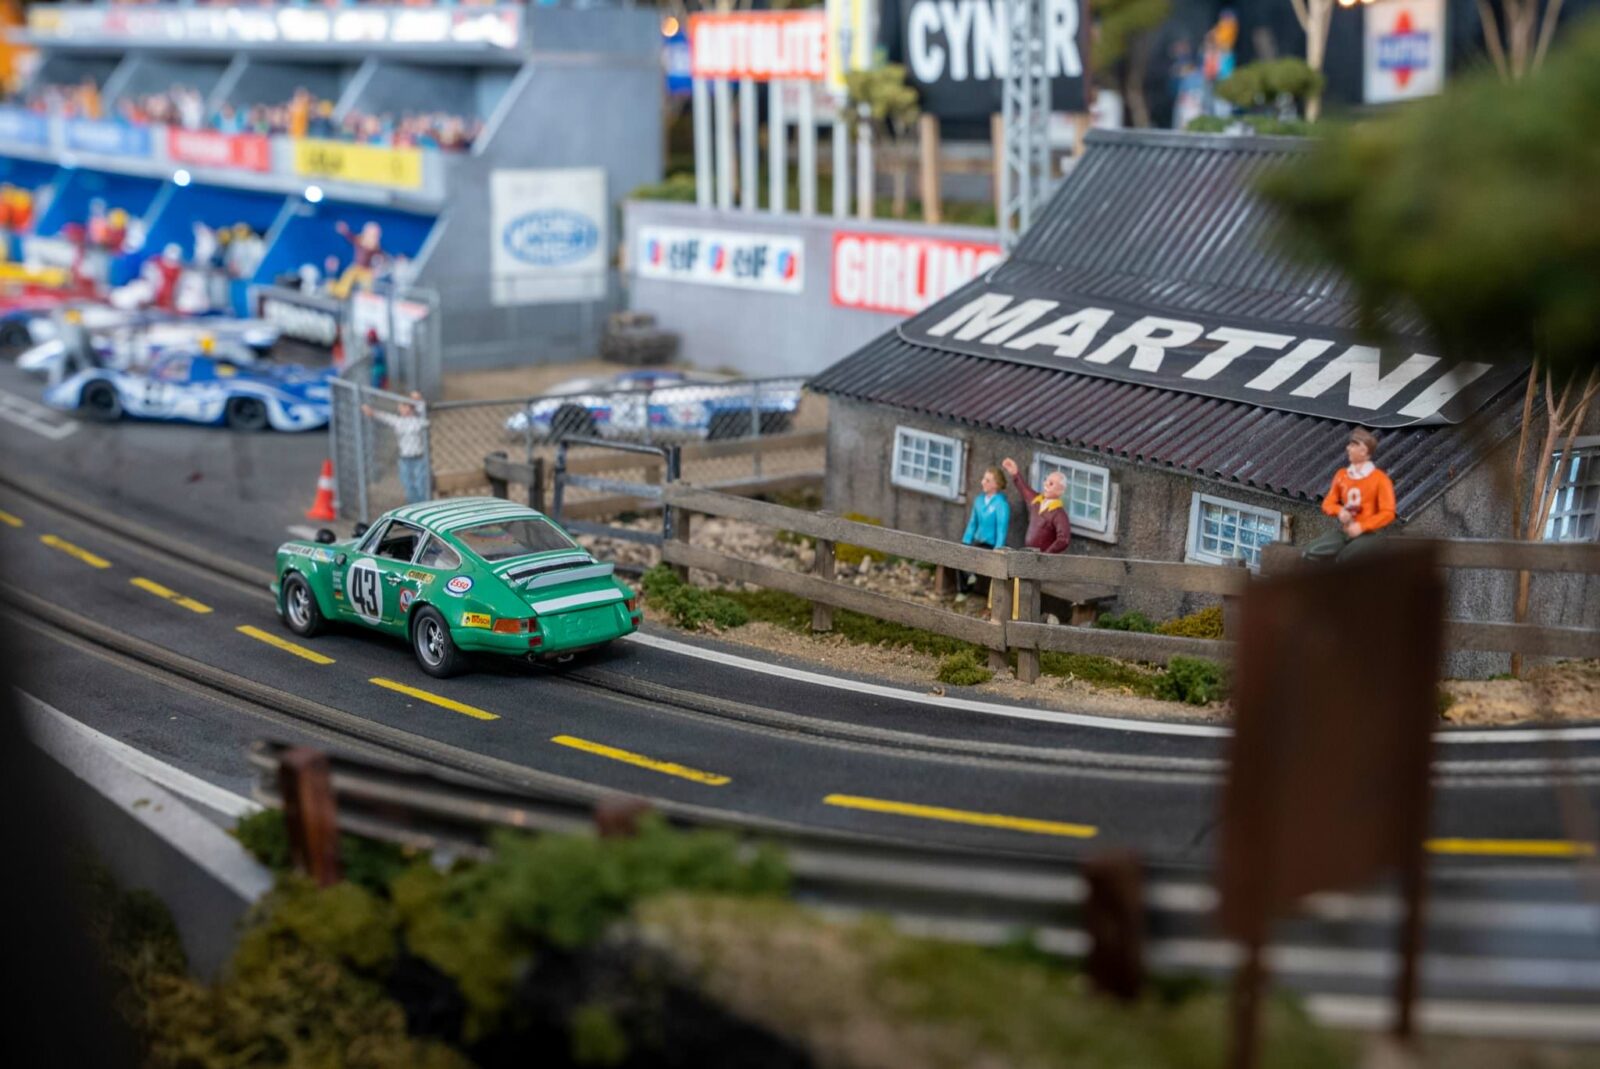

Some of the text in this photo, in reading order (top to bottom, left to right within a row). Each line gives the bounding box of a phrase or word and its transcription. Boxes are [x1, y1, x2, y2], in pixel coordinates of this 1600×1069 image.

[908, 0, 1082, 83] CYNR
[926, 292, 1494, 418] MARTINI
[352, 566, 379, 618] 43
